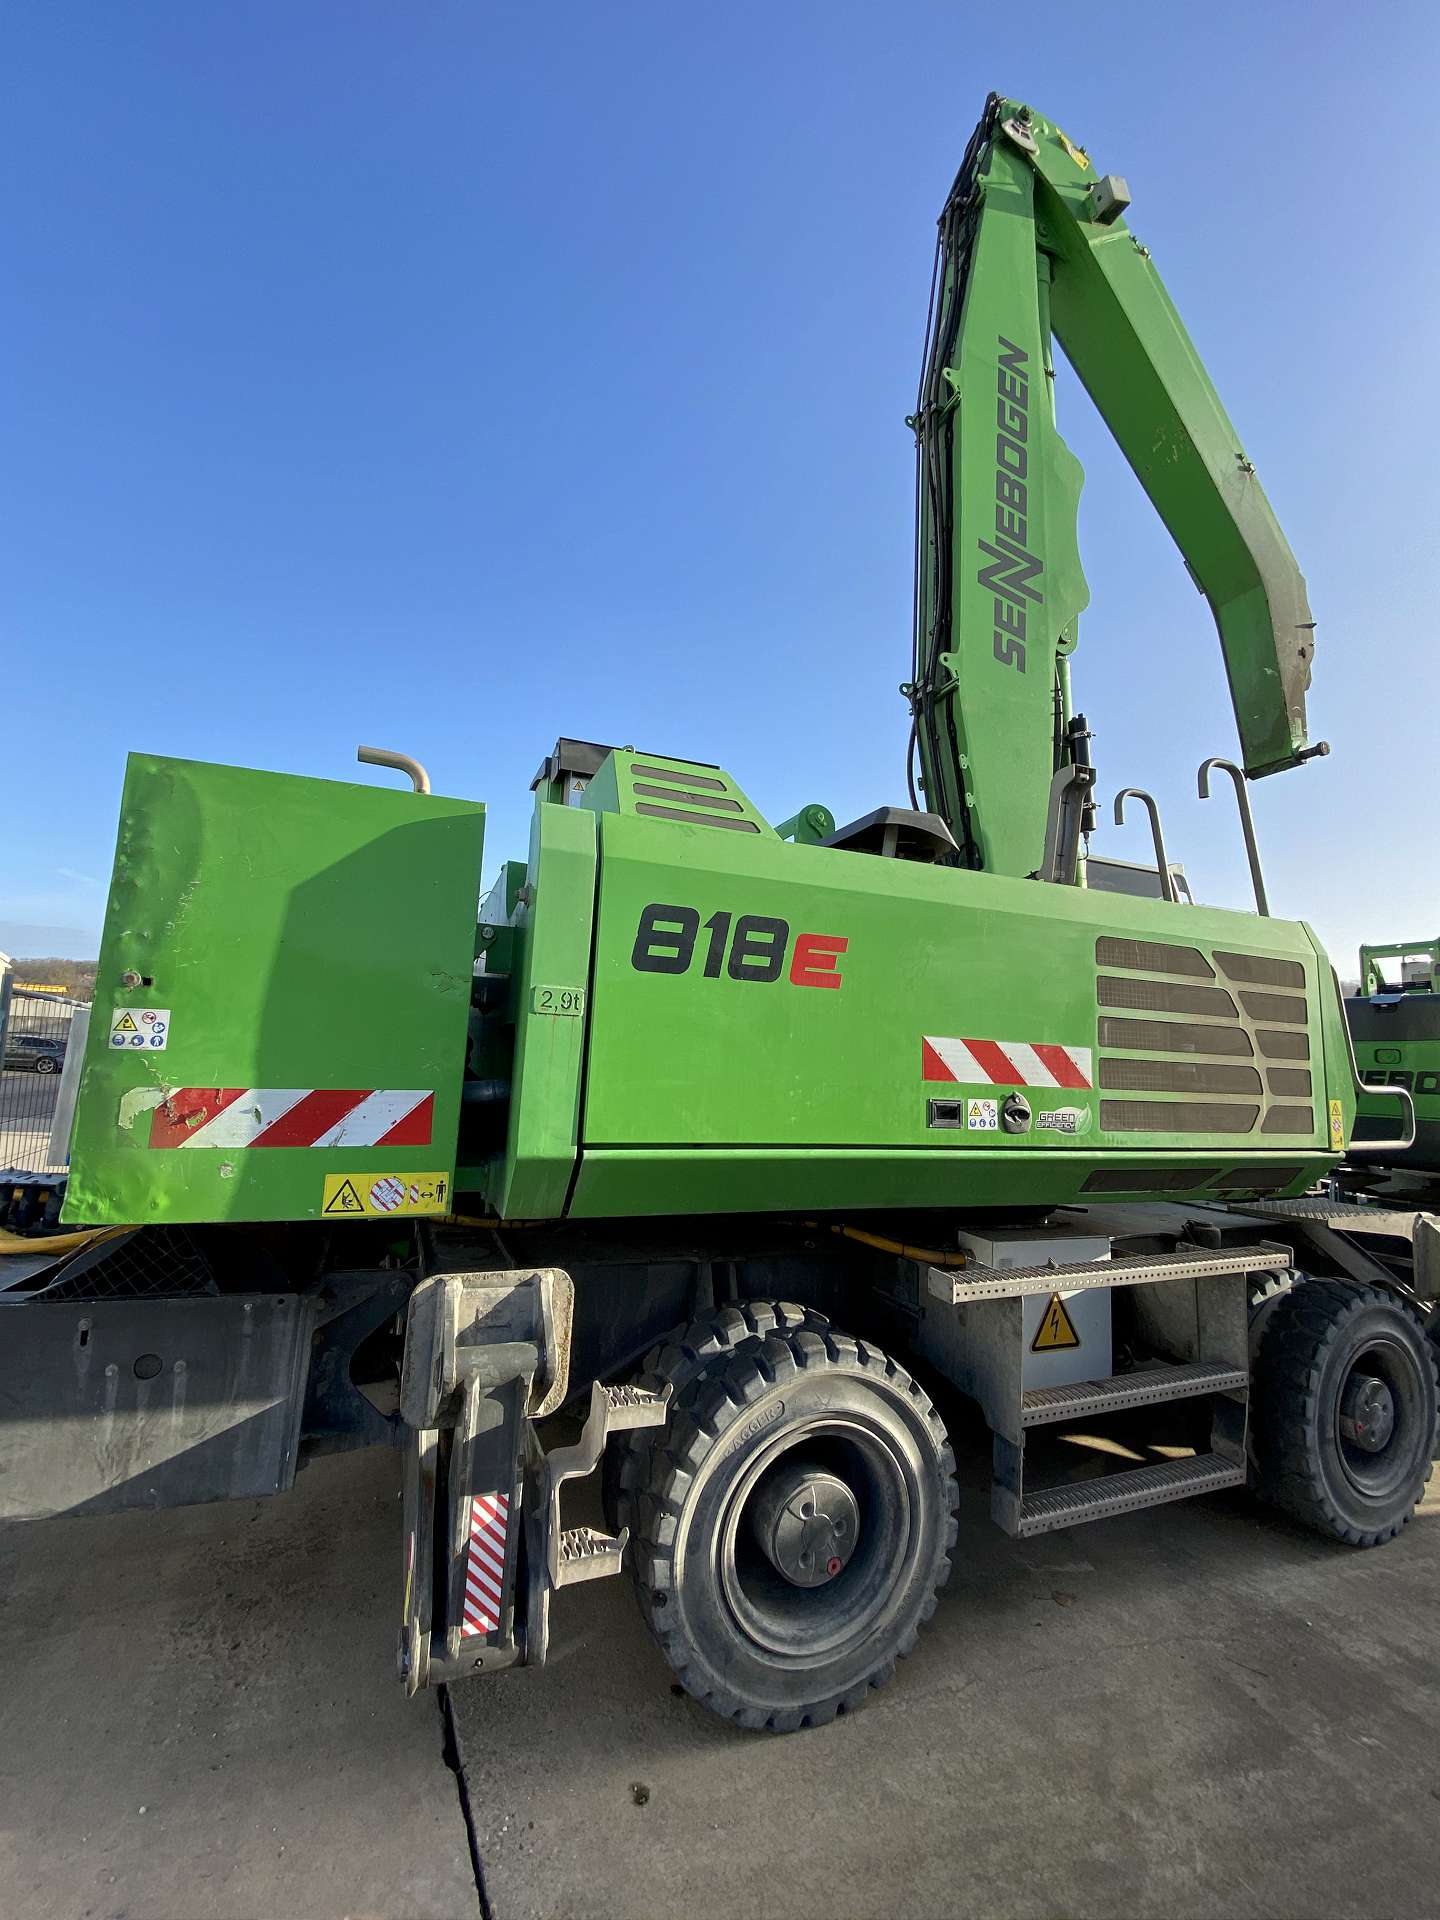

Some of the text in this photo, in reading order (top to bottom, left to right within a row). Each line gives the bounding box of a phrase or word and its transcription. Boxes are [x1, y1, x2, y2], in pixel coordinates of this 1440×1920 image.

[977, 335, 1043, 673] SENNEBOGEN
[540, 990, 580, 1012] 2,9t
[1039, 1112, 1076, 1122] GREEN
